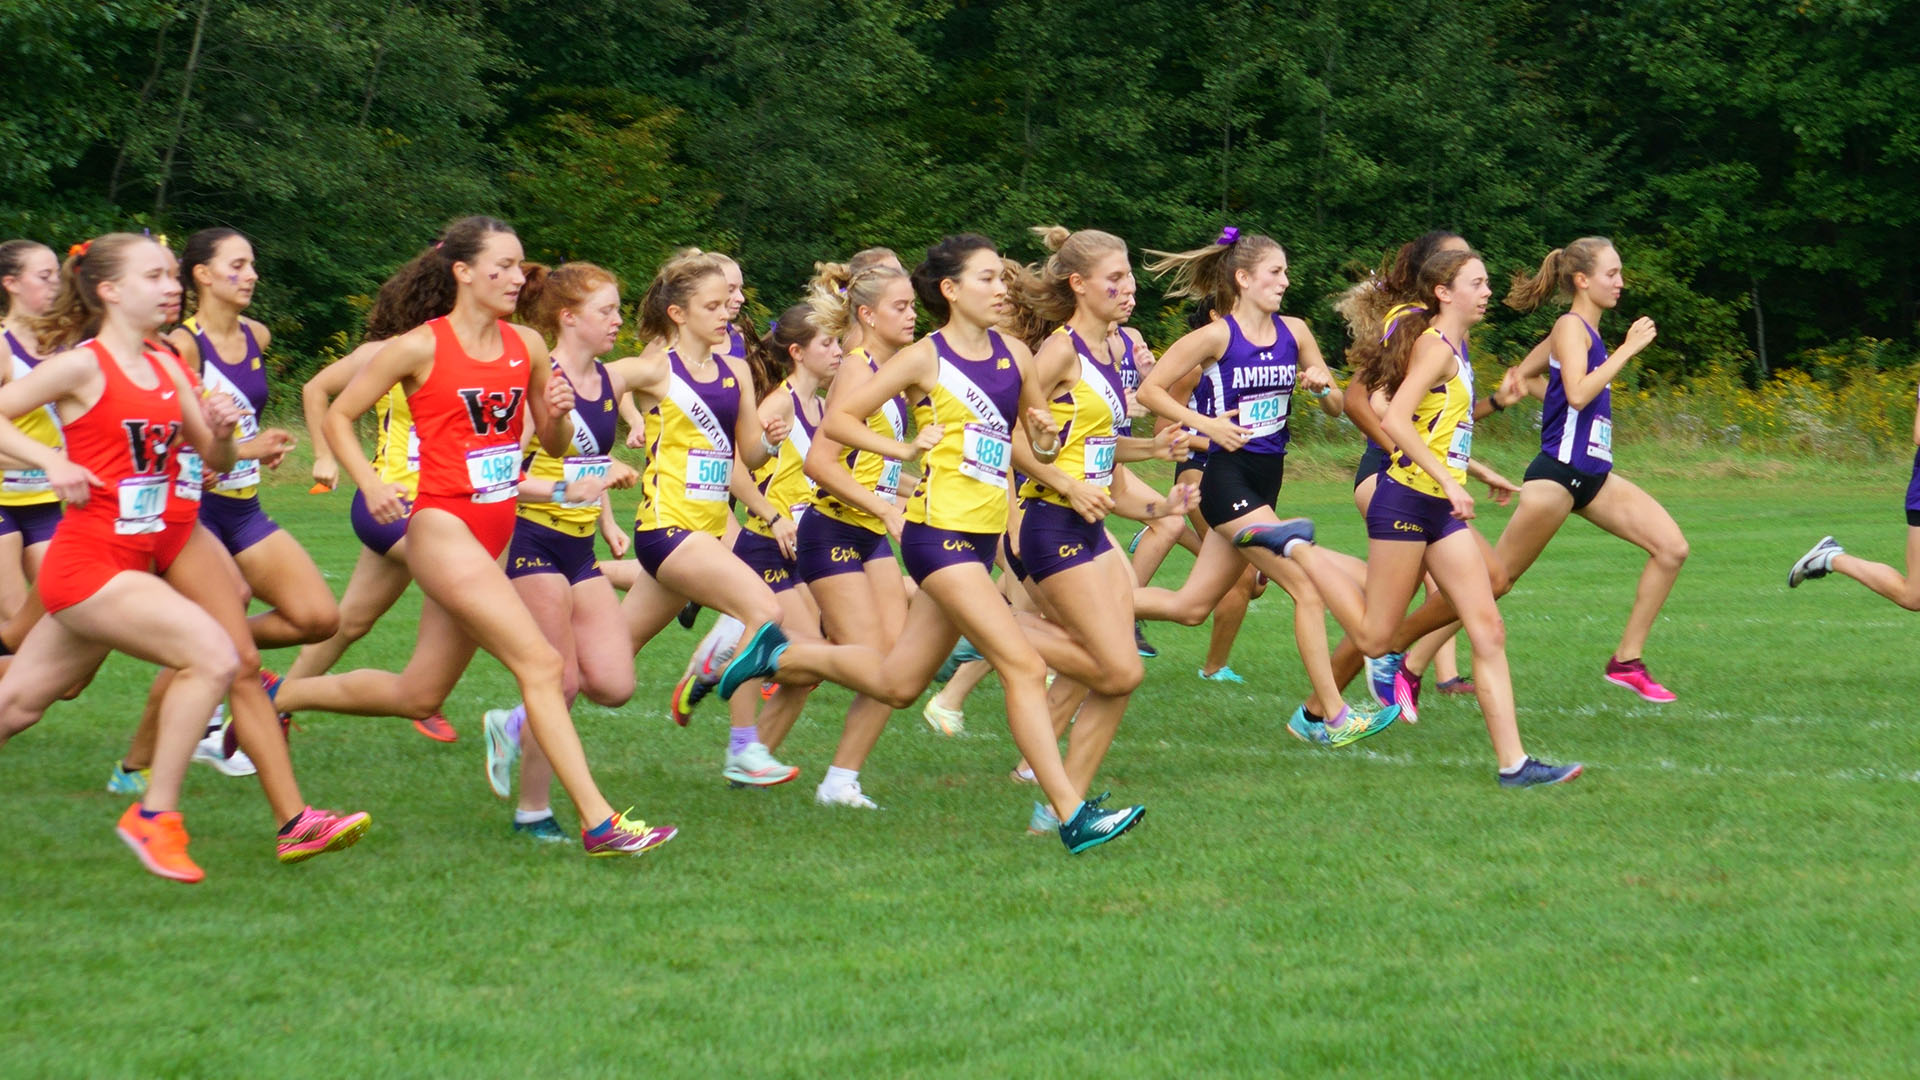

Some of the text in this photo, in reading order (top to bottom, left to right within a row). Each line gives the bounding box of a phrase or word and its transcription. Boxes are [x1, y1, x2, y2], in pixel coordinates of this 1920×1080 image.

[965, 386, 1006, 434] WILLIA
[1249, 397, 1279, 421] 429
[975, 437, 1005, 468] 489
[698, 459, 728, 484] 506
